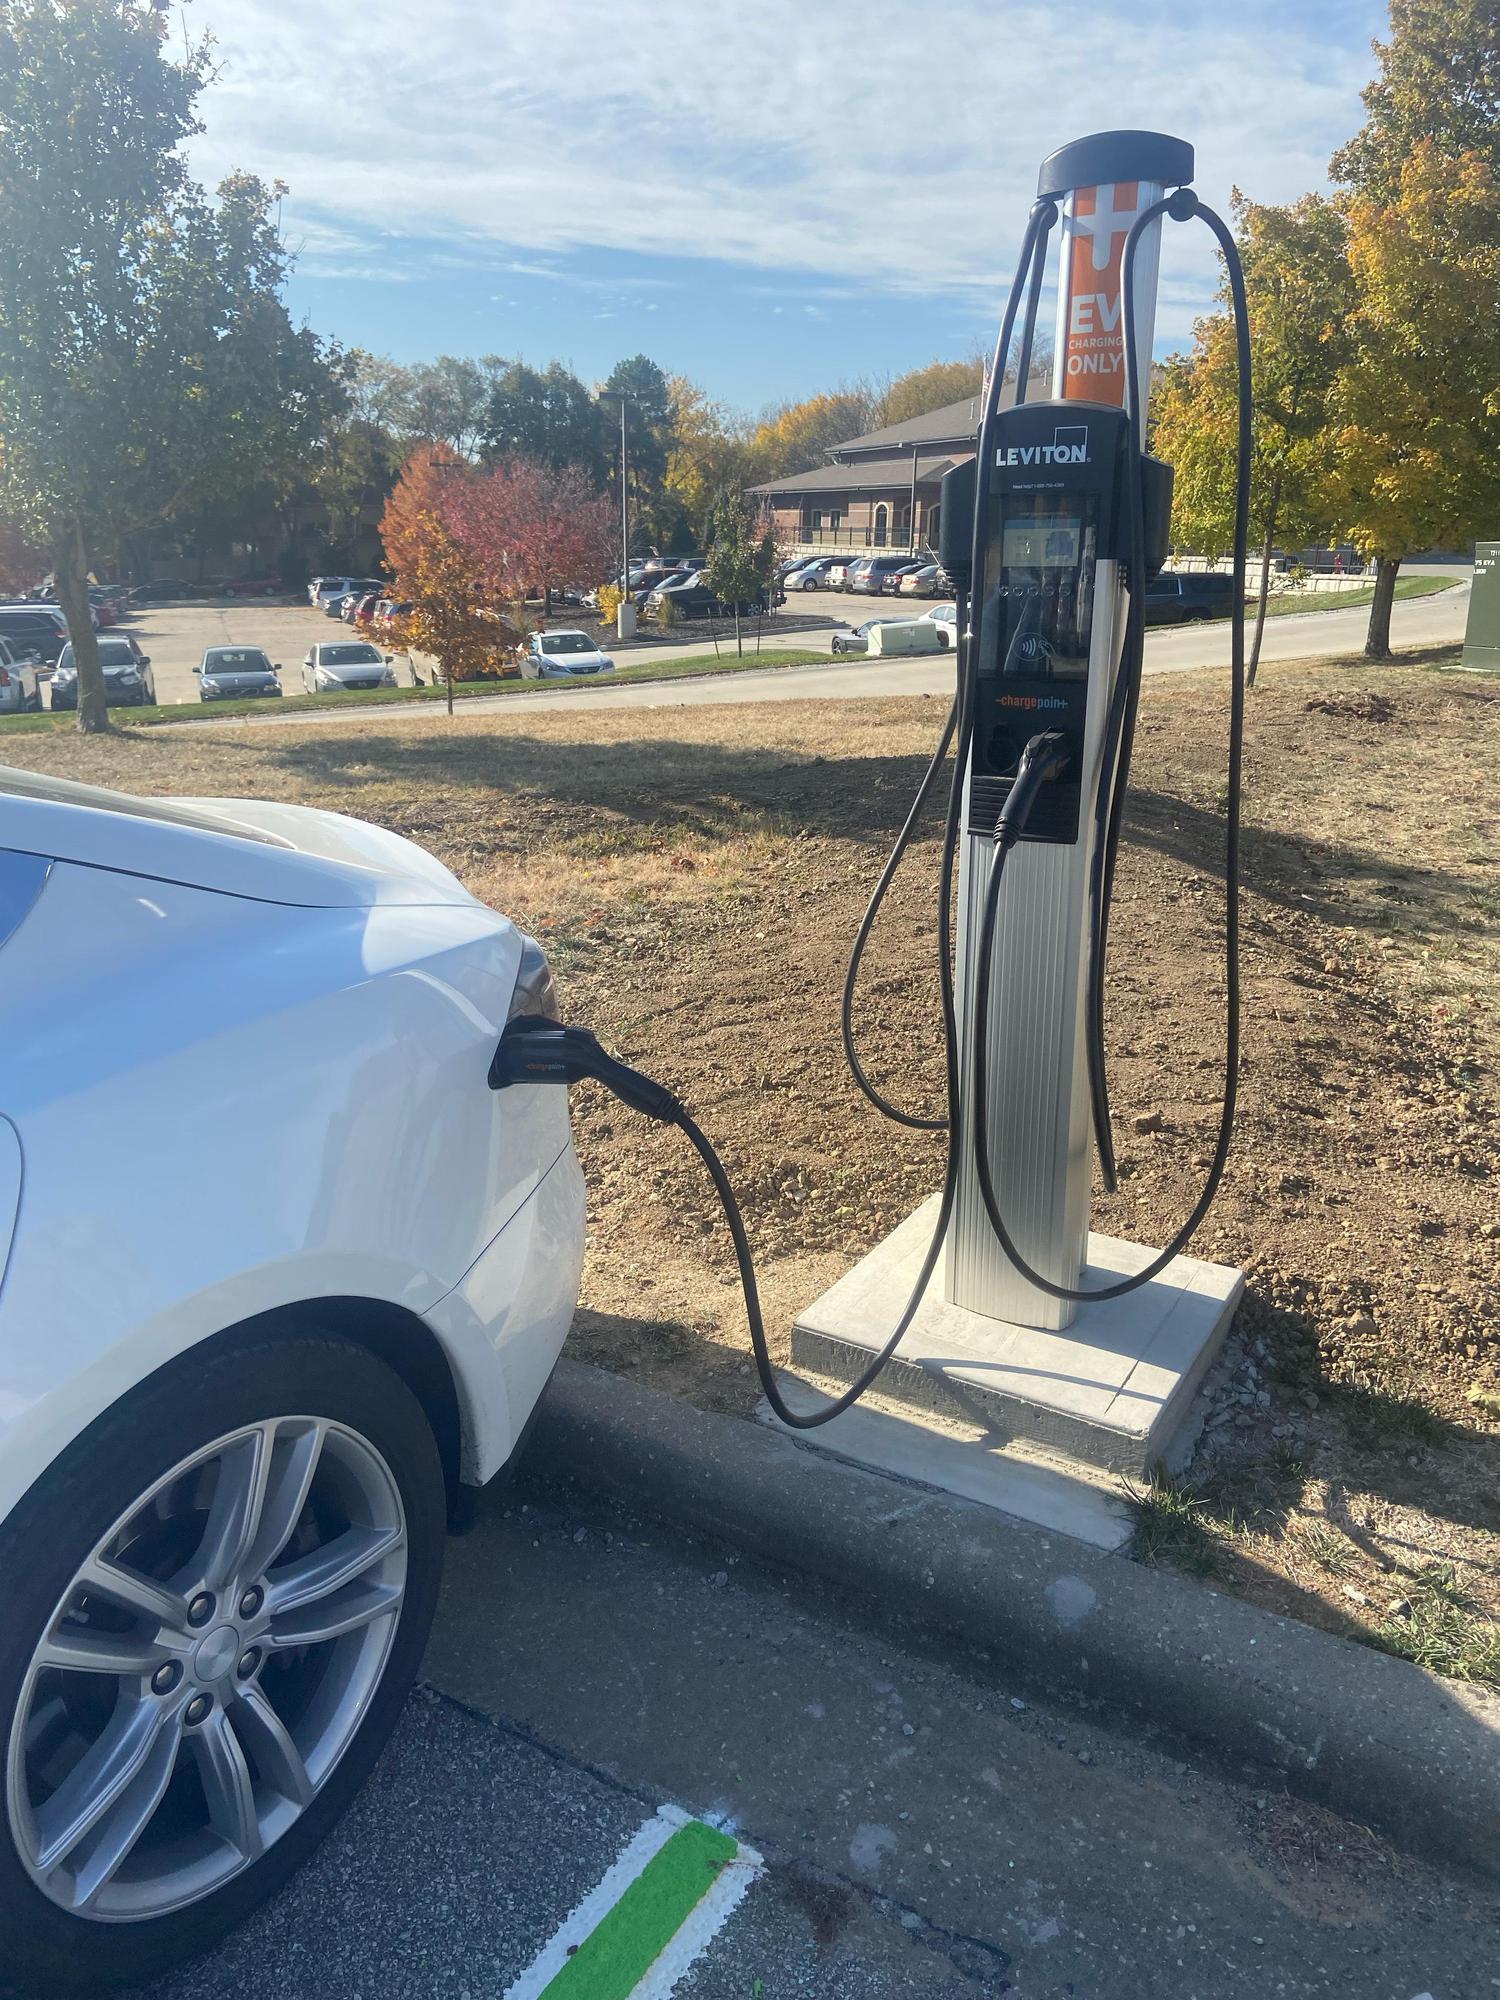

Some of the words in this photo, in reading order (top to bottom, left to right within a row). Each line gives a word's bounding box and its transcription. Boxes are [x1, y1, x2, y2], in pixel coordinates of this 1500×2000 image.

[1070, 292, 1122, 334] EV
[1068, 336, 1123, 350] CHARGING
[1067, 352, 1123, 376] ONLY
[995, 444, 1087, 467] LEVITON
